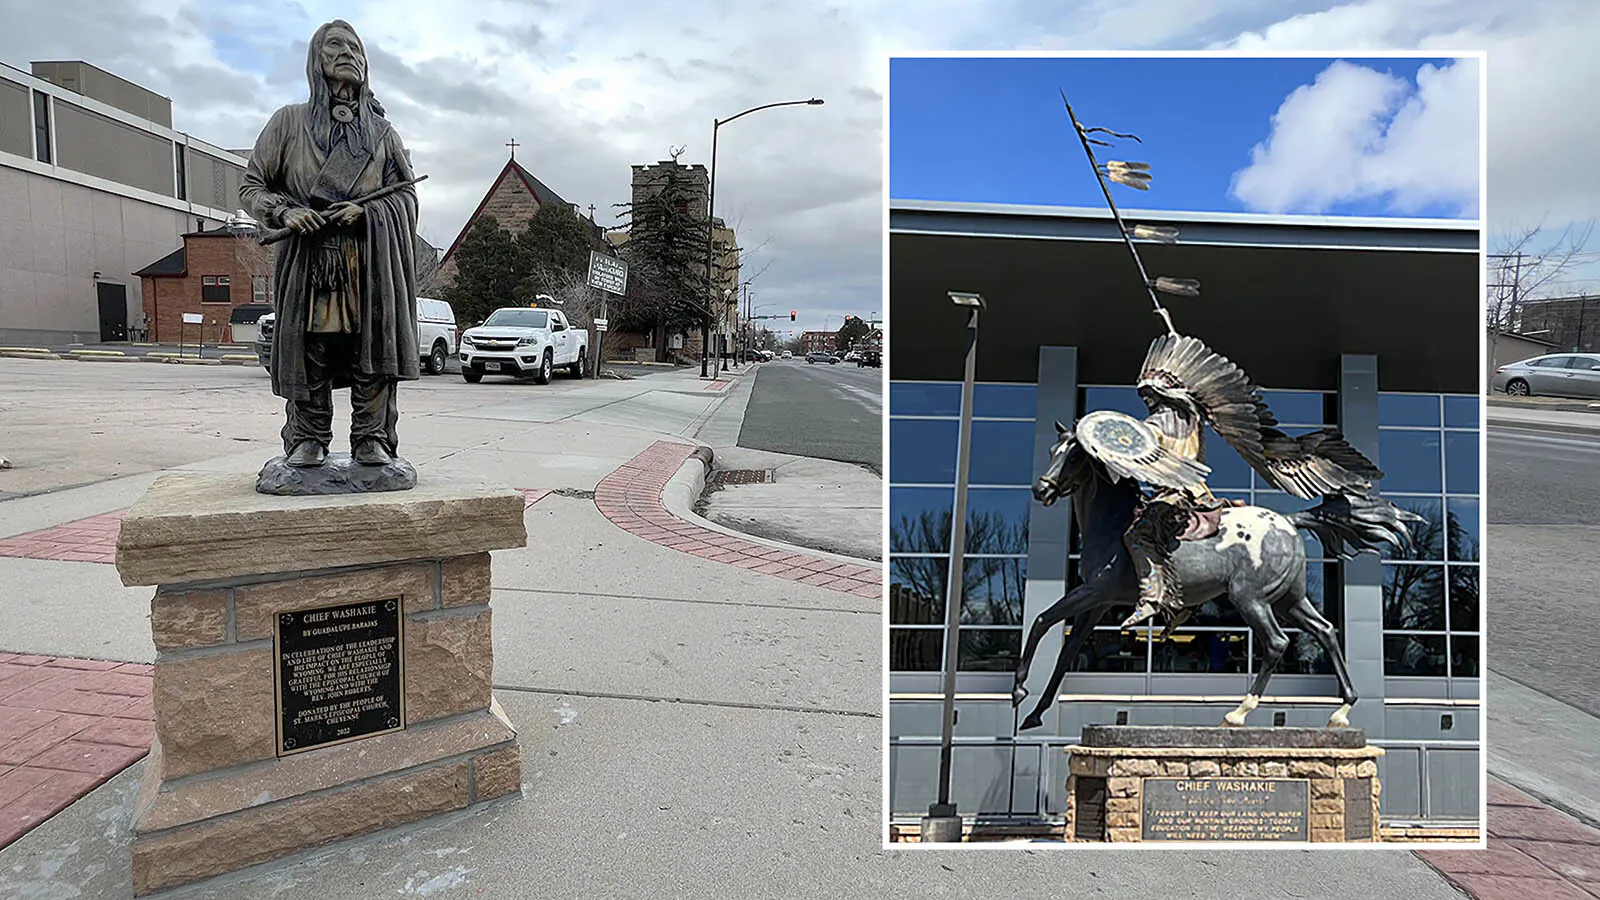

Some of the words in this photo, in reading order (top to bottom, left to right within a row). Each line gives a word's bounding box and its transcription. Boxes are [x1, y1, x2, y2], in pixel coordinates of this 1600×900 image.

[304, 612, 330, 624] CHIEF
[332, 605, 376, 620] WASHAKIE
[313, 624, 350, 636] GUADALUPE
[291, 646, 334, 659] CELEBRATION
[346, 642, 357, 650] THE
[359, 636, 395, 647] LEADERSHIP
[287, 658, 301, 666] AND
[327, 651, 345, 659] CHIEF
[347, 646, 378, 656] WASHAKIE
[306, 660, 329, 670] IMPACT
[341, 656, 352, 664] THE
[355, 652, 376, 661] PEOPLE
[338, 663, 350, 671] ARE
[352, 657, 386, 668] ESPECIALLY
[289, 675, 322, 686] GRATEFUL
[324, 672, 336, 680] FOR
[349, 663, 391, 675] RELATIONSHIP
[291, 684, 308, 692] WITH
[323, 675, 355, 687] EPISCOPAL
[357, 671, 380, 680] CHURCH
[304, 686, 334, 696] WYOMING
[350, 680, 366, 688] WITH
[312, 694, 326, 702] REV.
[328, 691, 343, 699] JOHN
[299, 706, 328, 717] DONATED
[340, 701, 351, 709] THE
[353, 697, 374, 707] PEOPLE
[329, 707, 361, 718] EPISCOPAL
[327, 714, 360, 725] CHEYENNE
[337, 728, 350, 736] 2022
[1176, 781, 1211, 791] CHIEF
[1216, 781, 1276, 792] WASHAKIE
